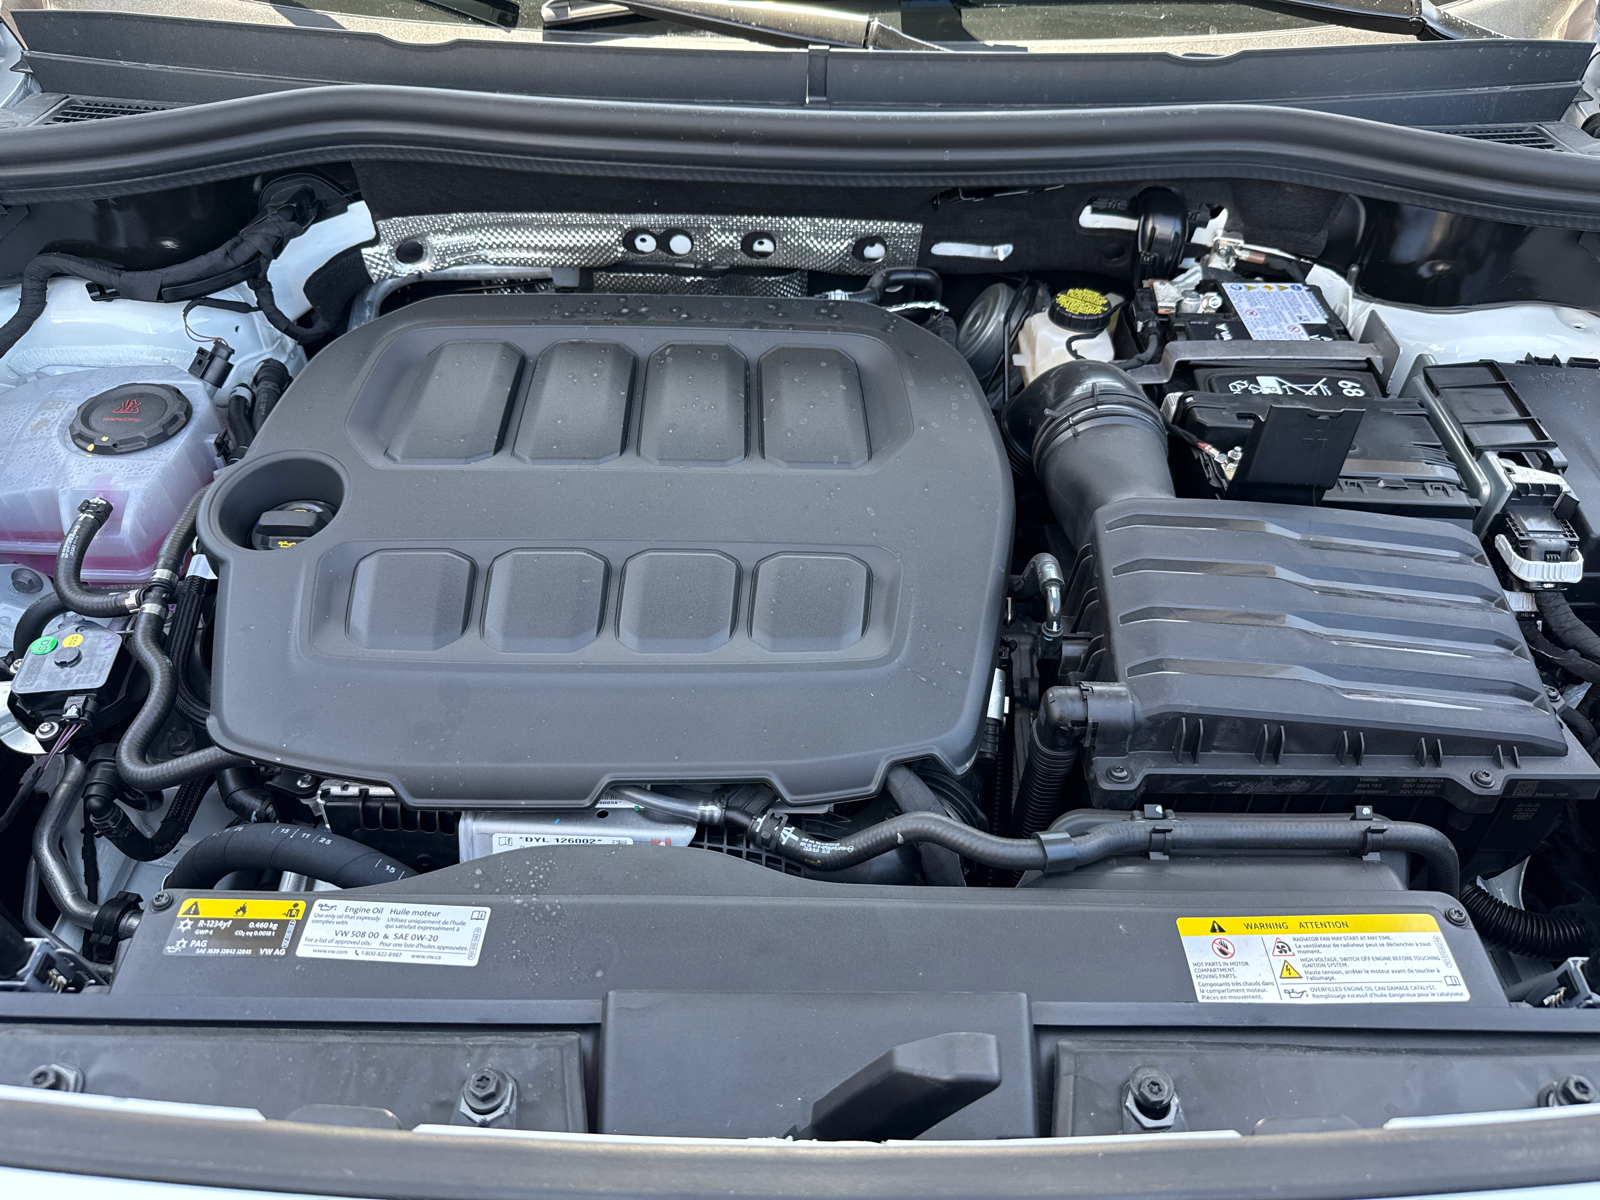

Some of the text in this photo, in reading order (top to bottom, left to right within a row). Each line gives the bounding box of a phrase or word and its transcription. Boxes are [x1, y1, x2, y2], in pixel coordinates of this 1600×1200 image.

[318, 837, 333, 845] 25
[385, 864, 396, 873] 15
[344, 905, 441, 917] Engine Oil Huile moteur
[324, 912, 336, 920] only
[355, 914, 381, 922] expressly
[197, 919, 278, 930] R-1234yf 0.460 kg
[408, 918, 441, 926] uniquement
[1243, 921, 1349, 930] WARNING ATTENTION
[395, 923, 416, 931] satisfait
[334, 929, 350, 937] VW
[350, 930, 367, 938] 508
[368, 931, 380, 939] 00
[393, 932, 410, 941] SAE
[410, 933, 439, 942] 0W-20
[189, 939, 208, 948] PAG
[328, 937, 335, 945] of
[259, 948, 274, 956] VW
[274, 948, 286, 956] AG
